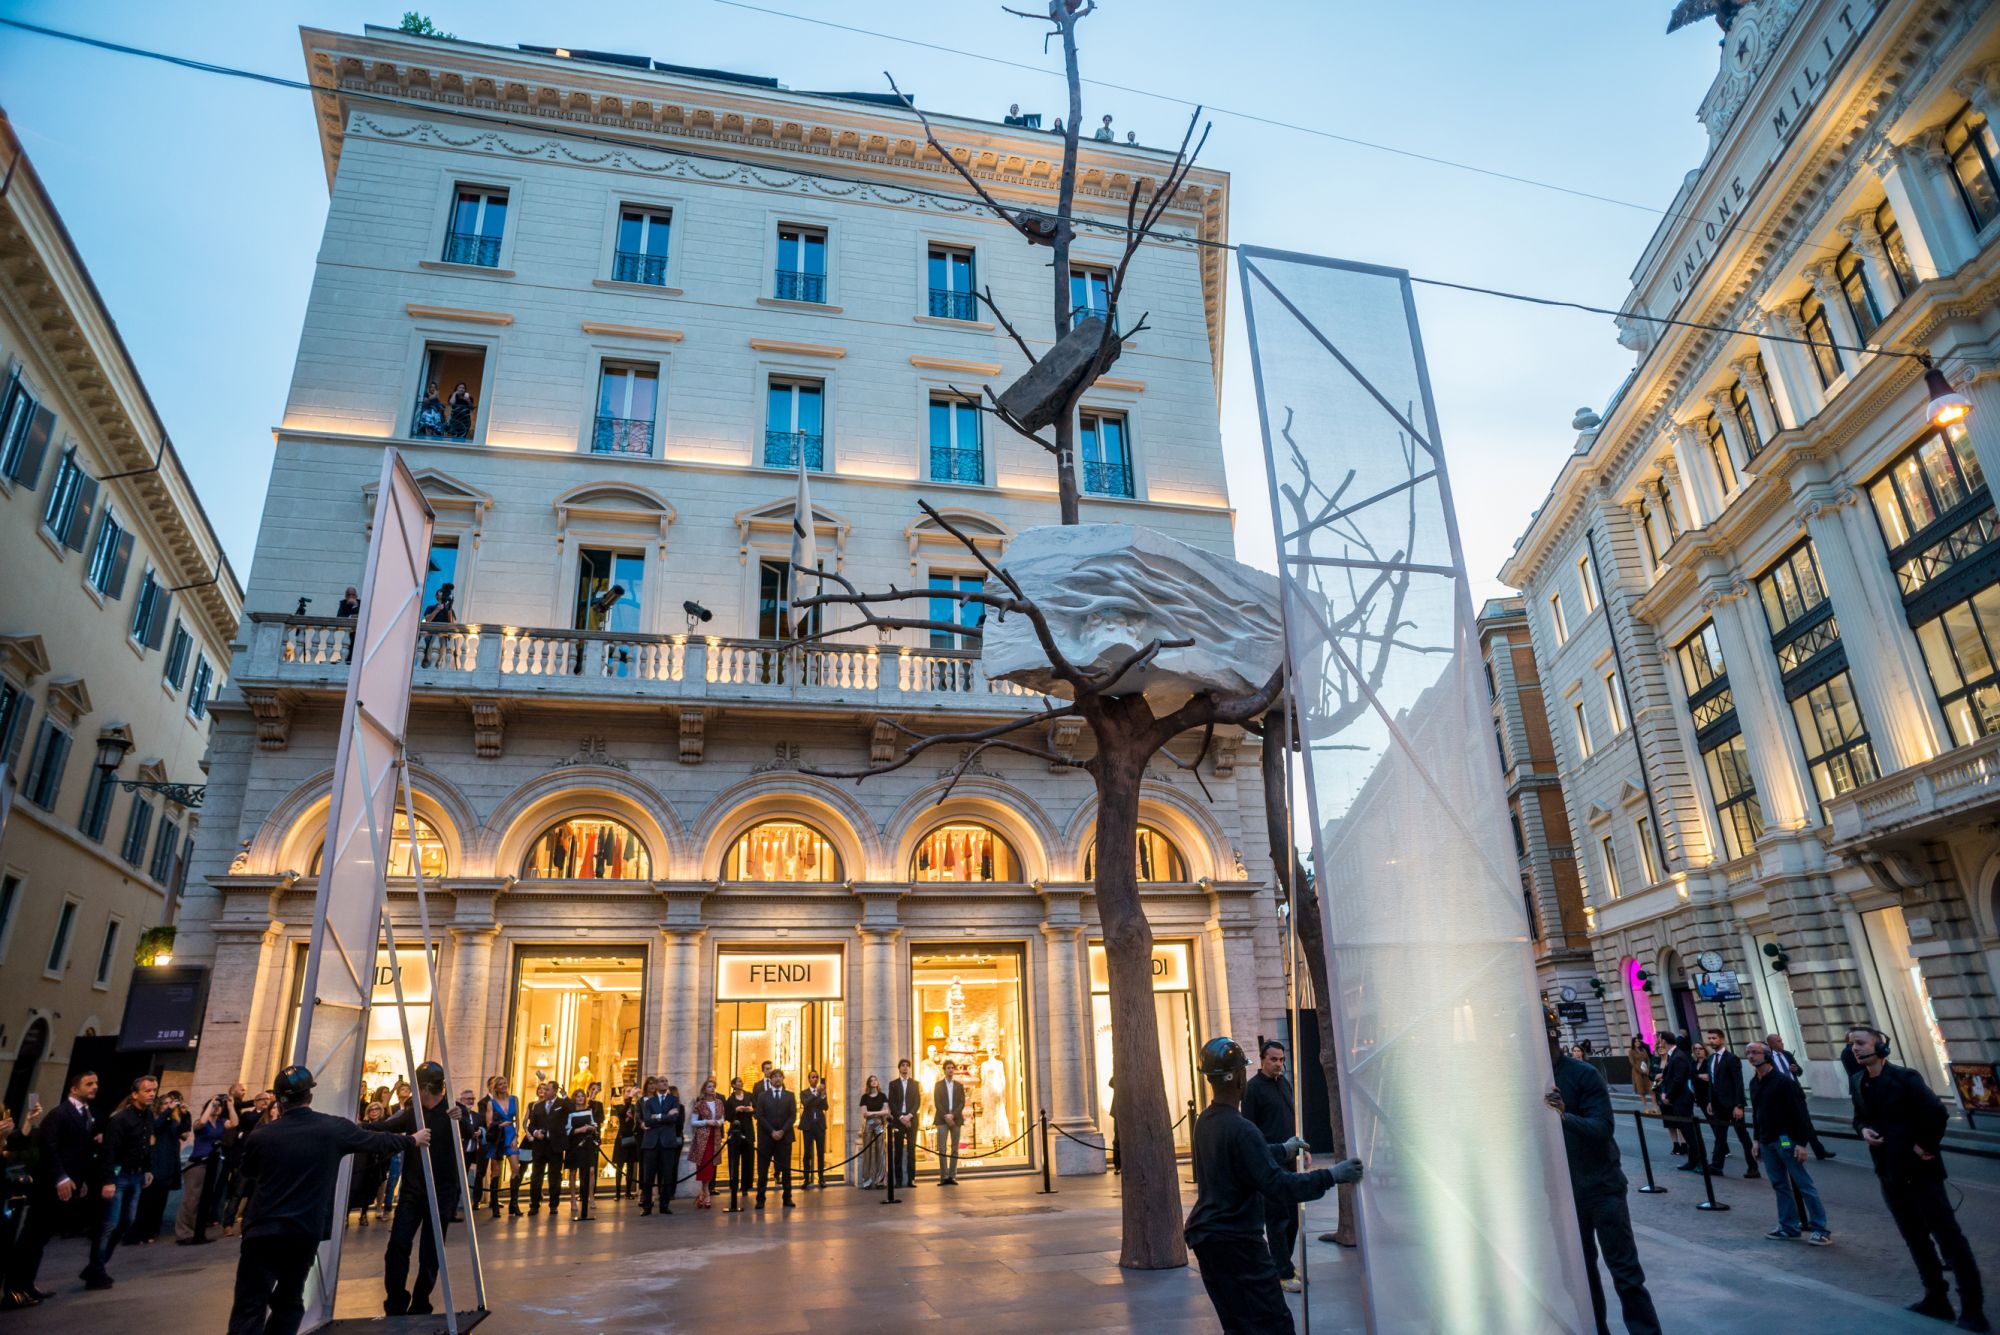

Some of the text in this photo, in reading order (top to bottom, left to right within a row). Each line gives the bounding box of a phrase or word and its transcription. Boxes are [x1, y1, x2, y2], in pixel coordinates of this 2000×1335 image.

[1673, 0, 1872, 293] UNIONE MILIT
[750, 964, 811, 982] FENDI
[157, 1030, 185, 1038] zuma
